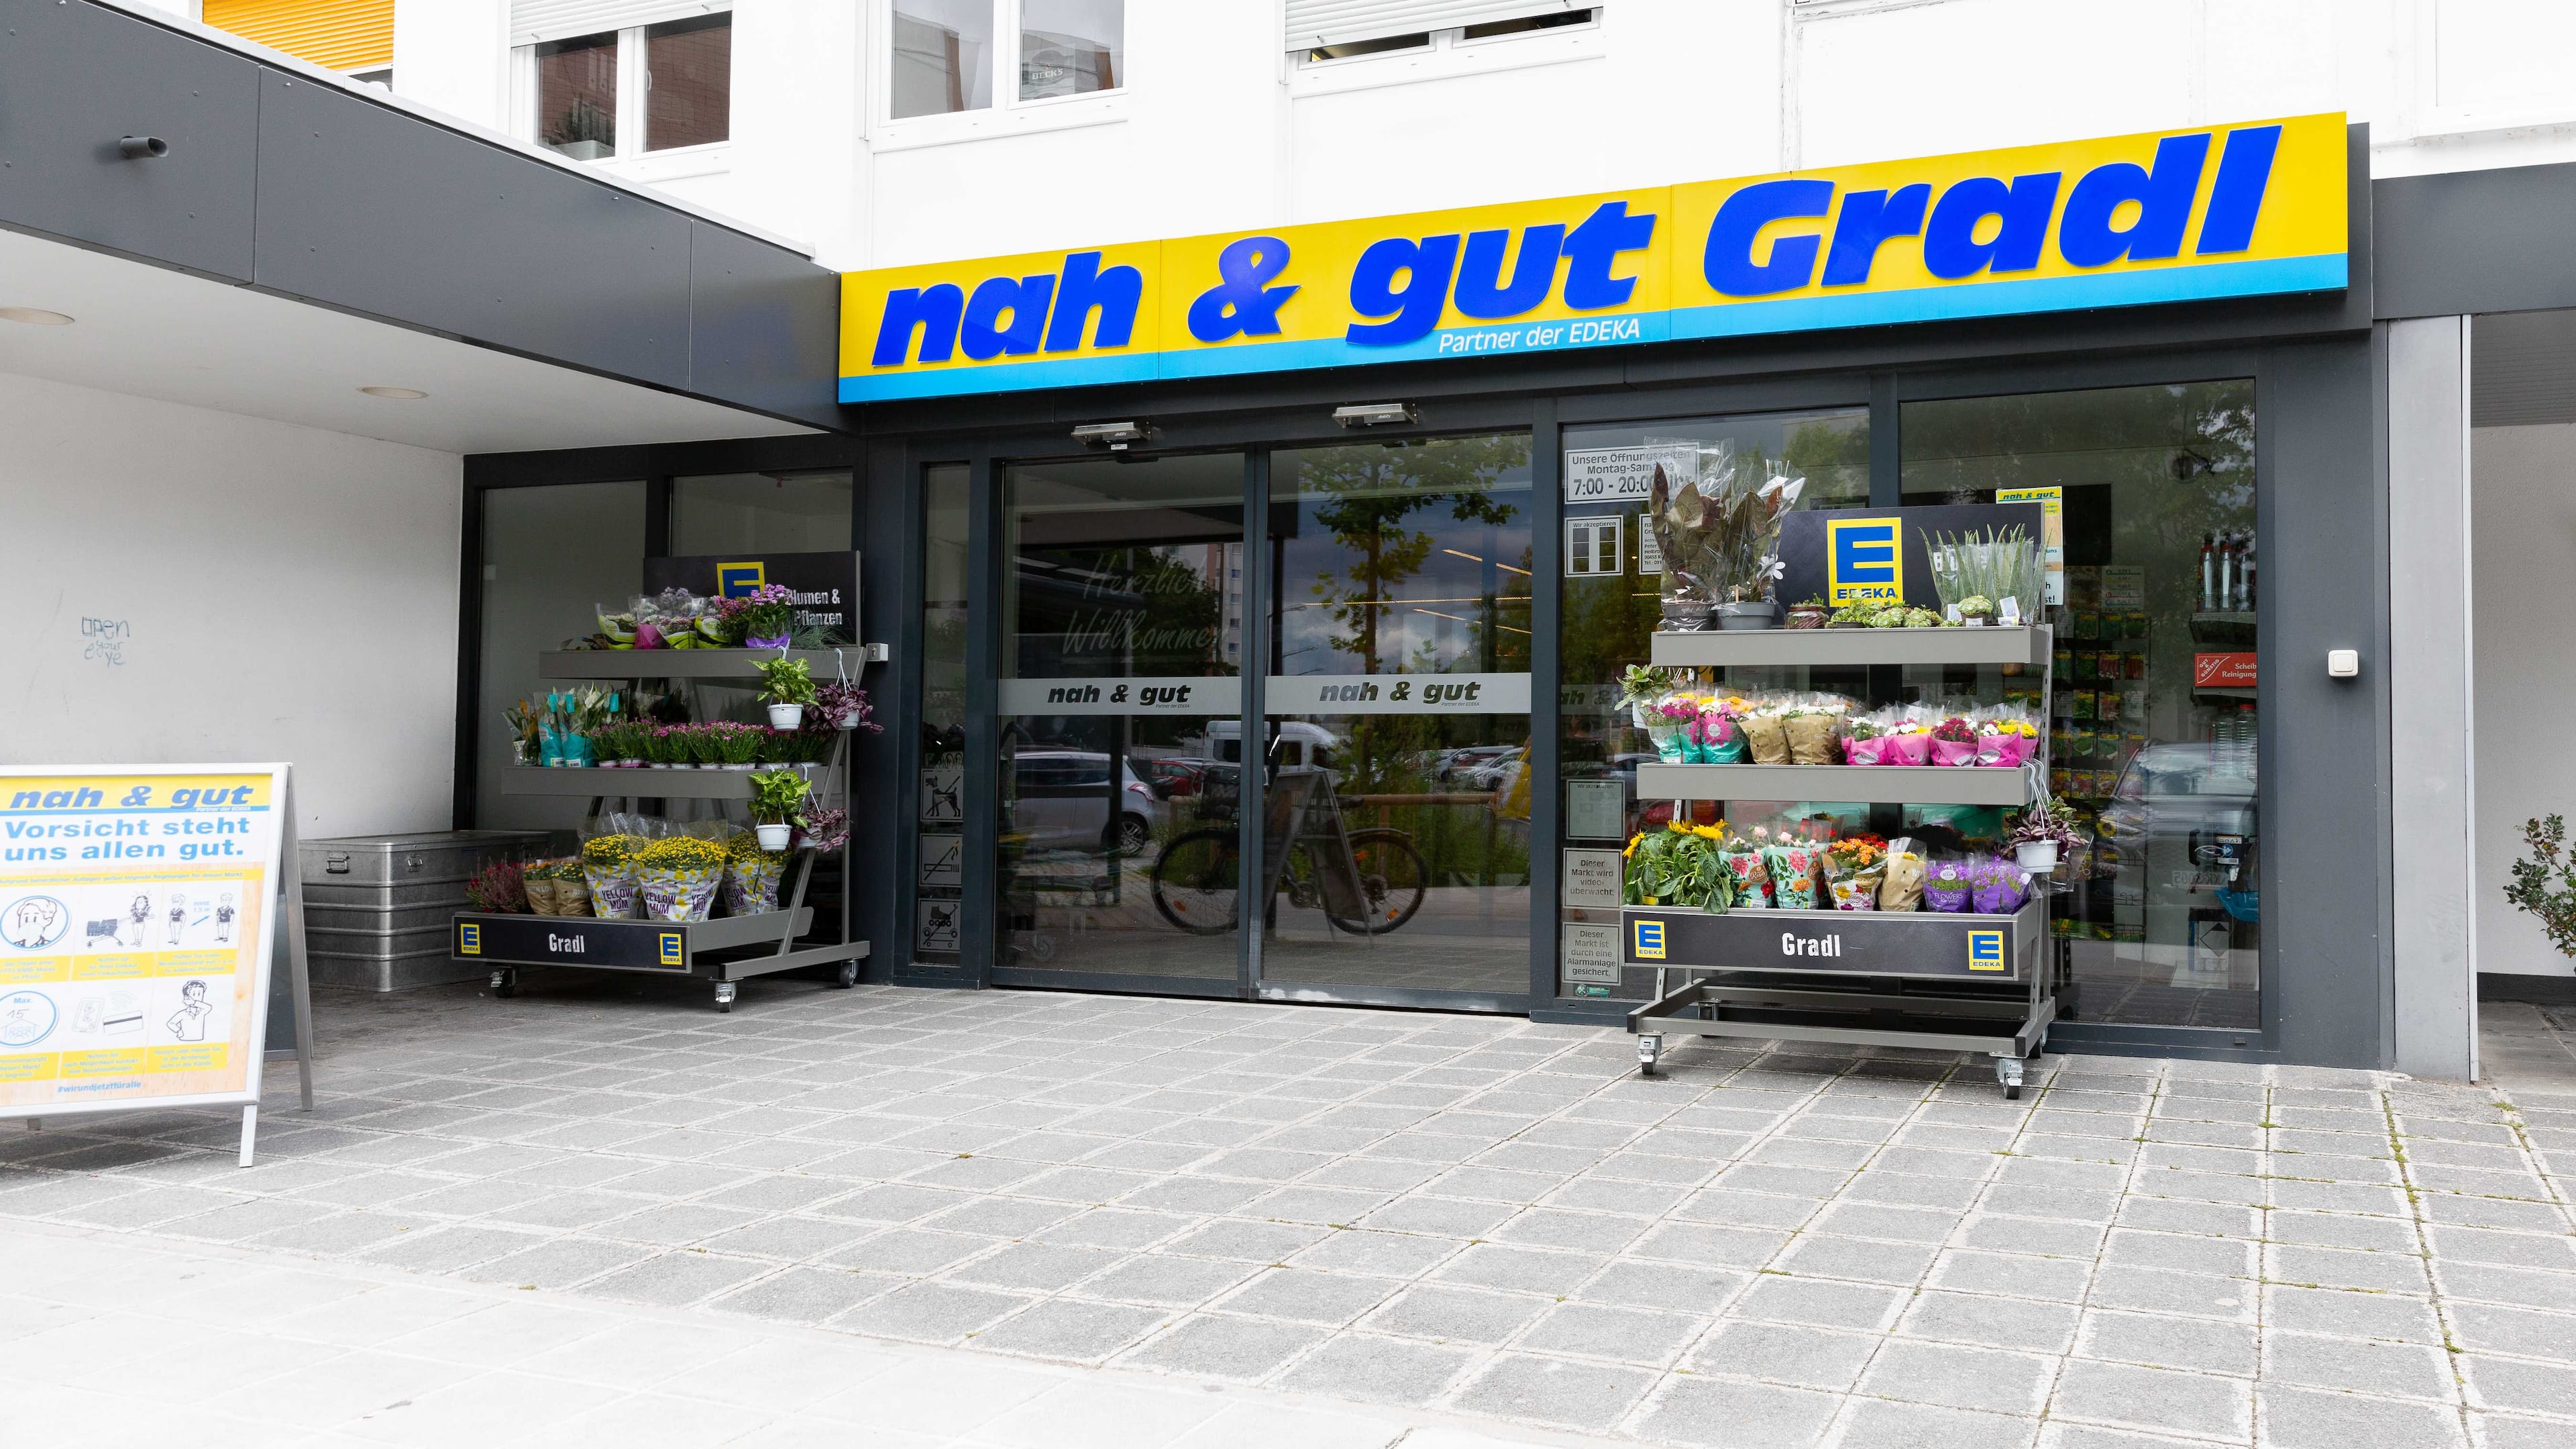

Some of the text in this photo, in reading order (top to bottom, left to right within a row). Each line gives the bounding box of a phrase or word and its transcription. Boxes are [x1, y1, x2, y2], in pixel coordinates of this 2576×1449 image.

[872, 125, 2282, 367] nah & gut Gradl
[1439, 318, 1640, 353] Partner der EDEKA
[1572, 450, 1690, 464] Unsere Öffnungszeiten
[1587, 462, 1674, 474] Montag-Samag
[1574, 477, 1604, 495] 7:00
[2036, 491, 2054, 499] gut
[1835, 526, 1894, 583] E
[1083, 552, 1208, 600] Herzlich
[832, 588, 841, 604] &
[794, 610, 843, 625] Pflanzen
[1062, 607, 1228, 655] Willkommen
[2222, 671, 2257, 679] Reinigung
[1047, 684, 1191, 706] nah & gut
[1320, 681, 1481, 704] nah & gut
[10, 786, 254, 810] nah & gut
[5, 817, 250, 839] Vorsicht steht
[5, 839, 244, 861] uns allen gut.
[1580, 859, 1605, 867] Dieser
[602, 888, 633, 901] YELLOW
[645, 891, 676, 905] YELLOW
[1570, 887, 1614, 896] überwacht.
[1934, 892, 1964, 901] FLOWERS
[610, 899, 629, 909] MUM
[649, 903, 669, 914] MUM
[463, 927, 478, 945] E
[549, 933, 585, 953] Gradl
[1574, 939, 1597, 947] Markt
[1638, 924, 1662, 948] E
[1782, 932, 1841, 957] Gradl
[662, 936, 680, 956] E
[1571, 949, 1613, 957] durch eine
[1972, 934, 1999, 959] E
[1567, 958, 1616, 967] Alarmanlage
[1572, 967, 1611, 977] gesichert.
